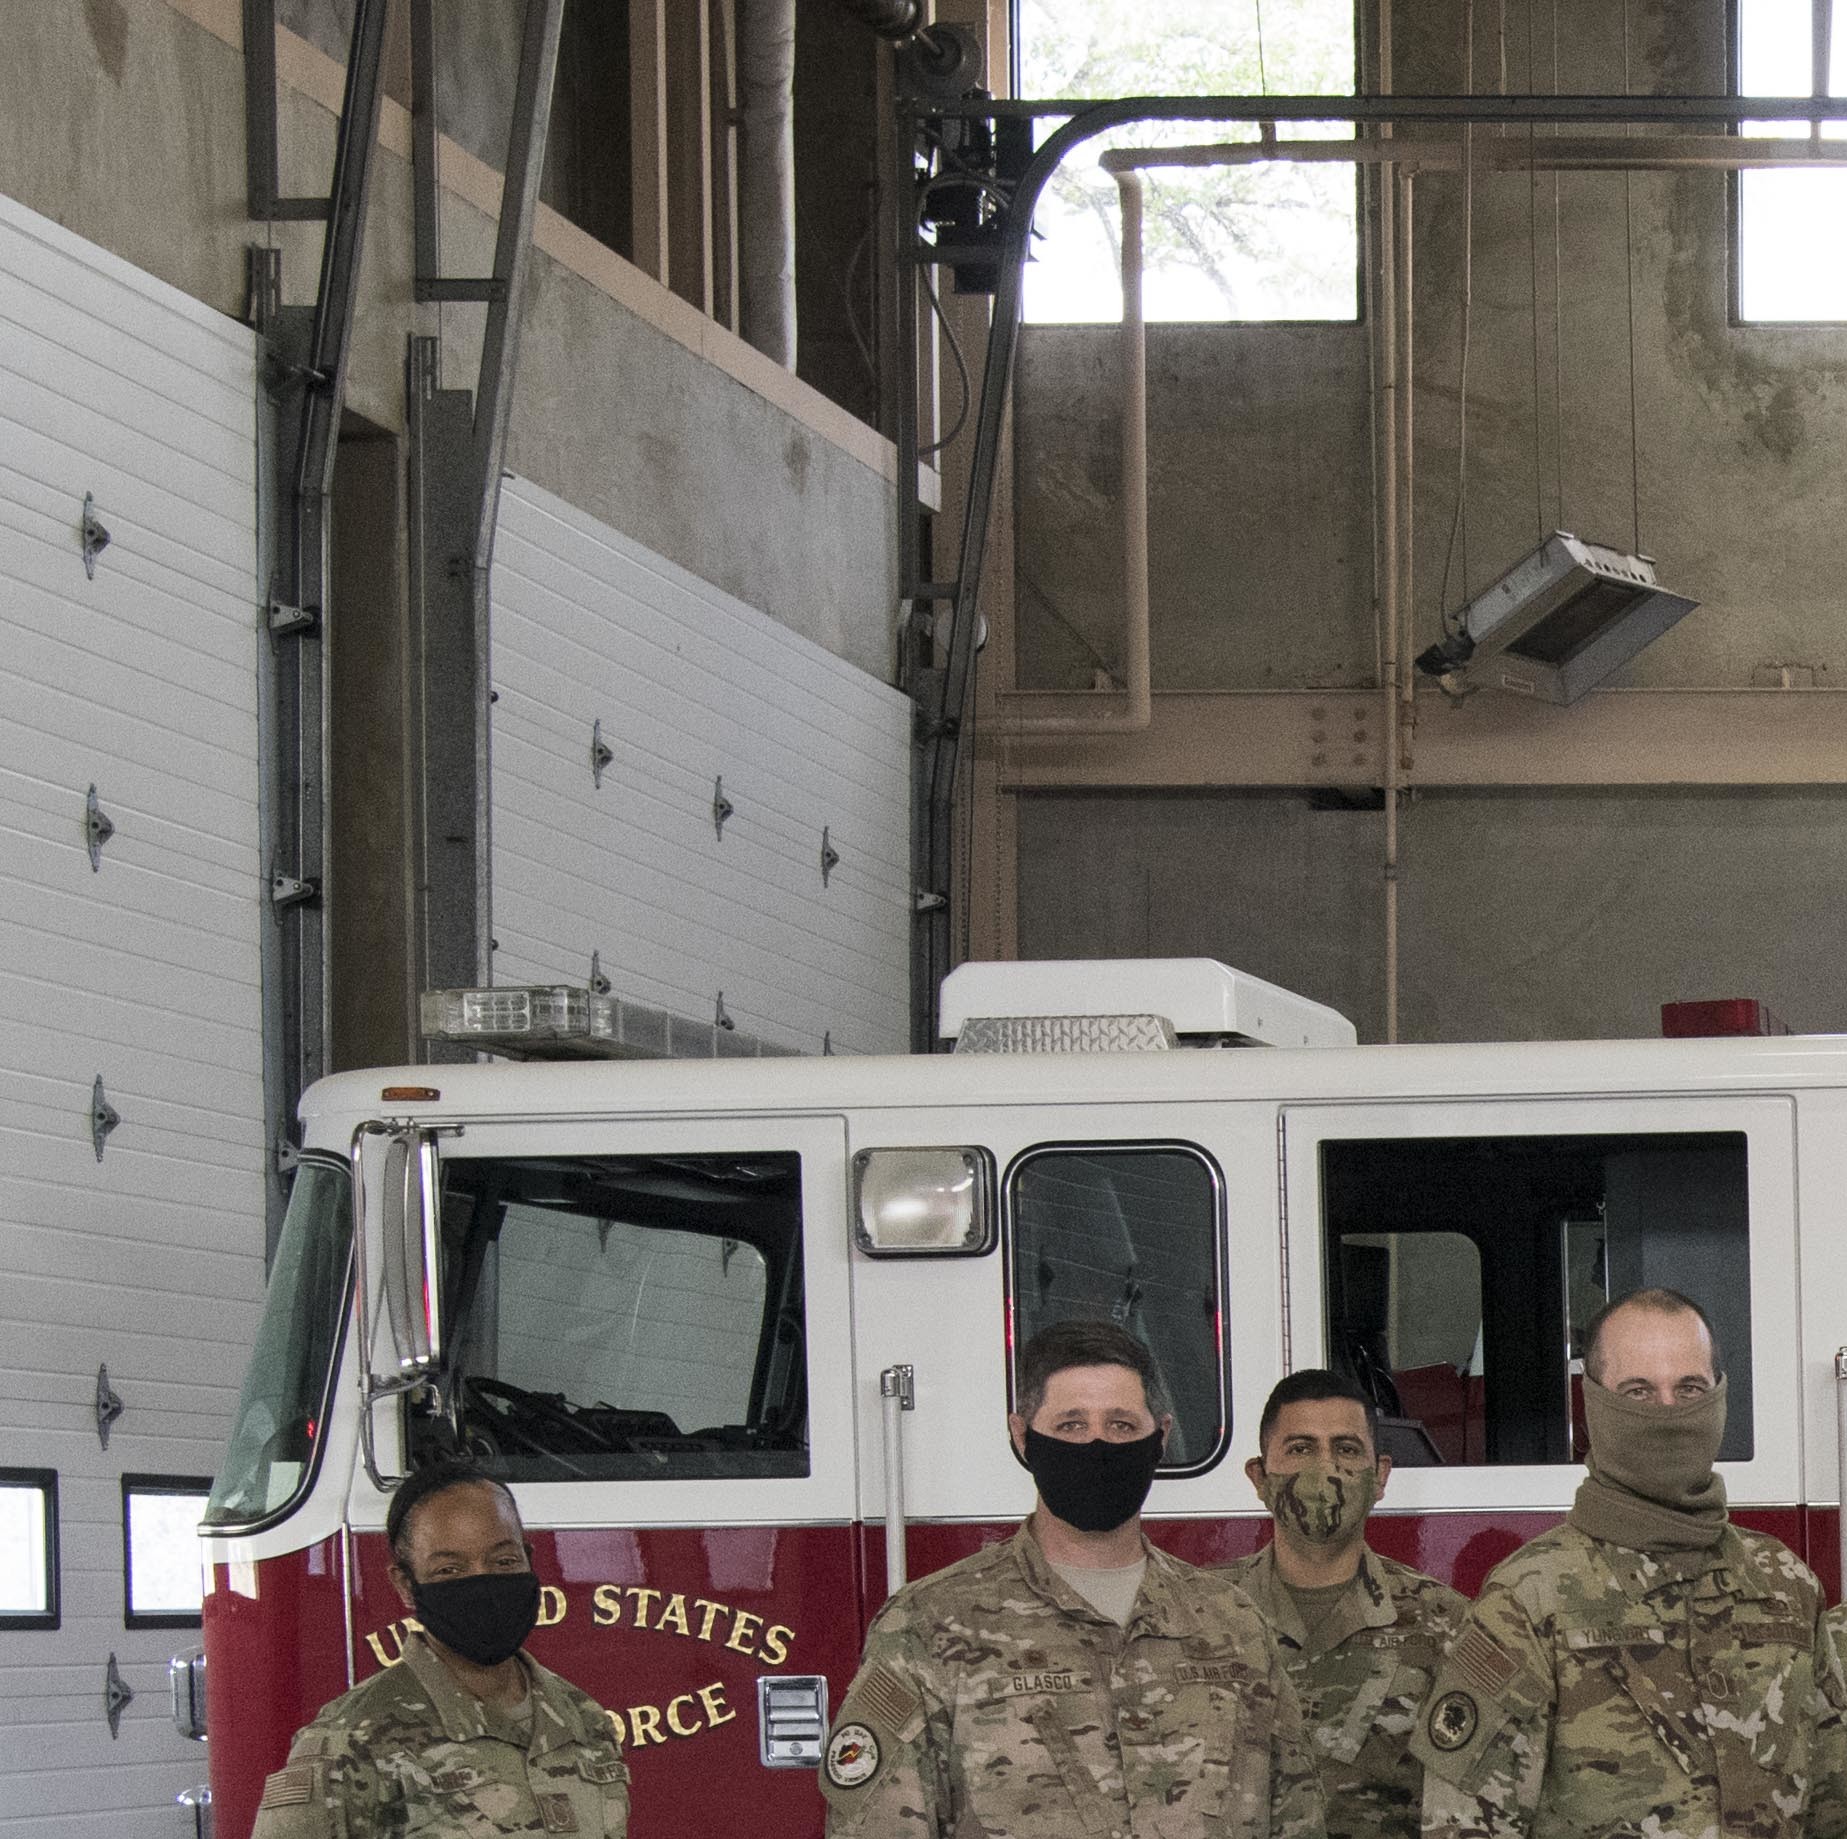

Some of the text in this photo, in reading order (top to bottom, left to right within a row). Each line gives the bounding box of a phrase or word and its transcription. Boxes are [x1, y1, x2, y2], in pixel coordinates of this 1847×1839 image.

[592, 1583, 796, 1666] STATES
[604, 1681, 737, 1748] ORCE
[1012, 1675, 1073, 1692] GLASCO
